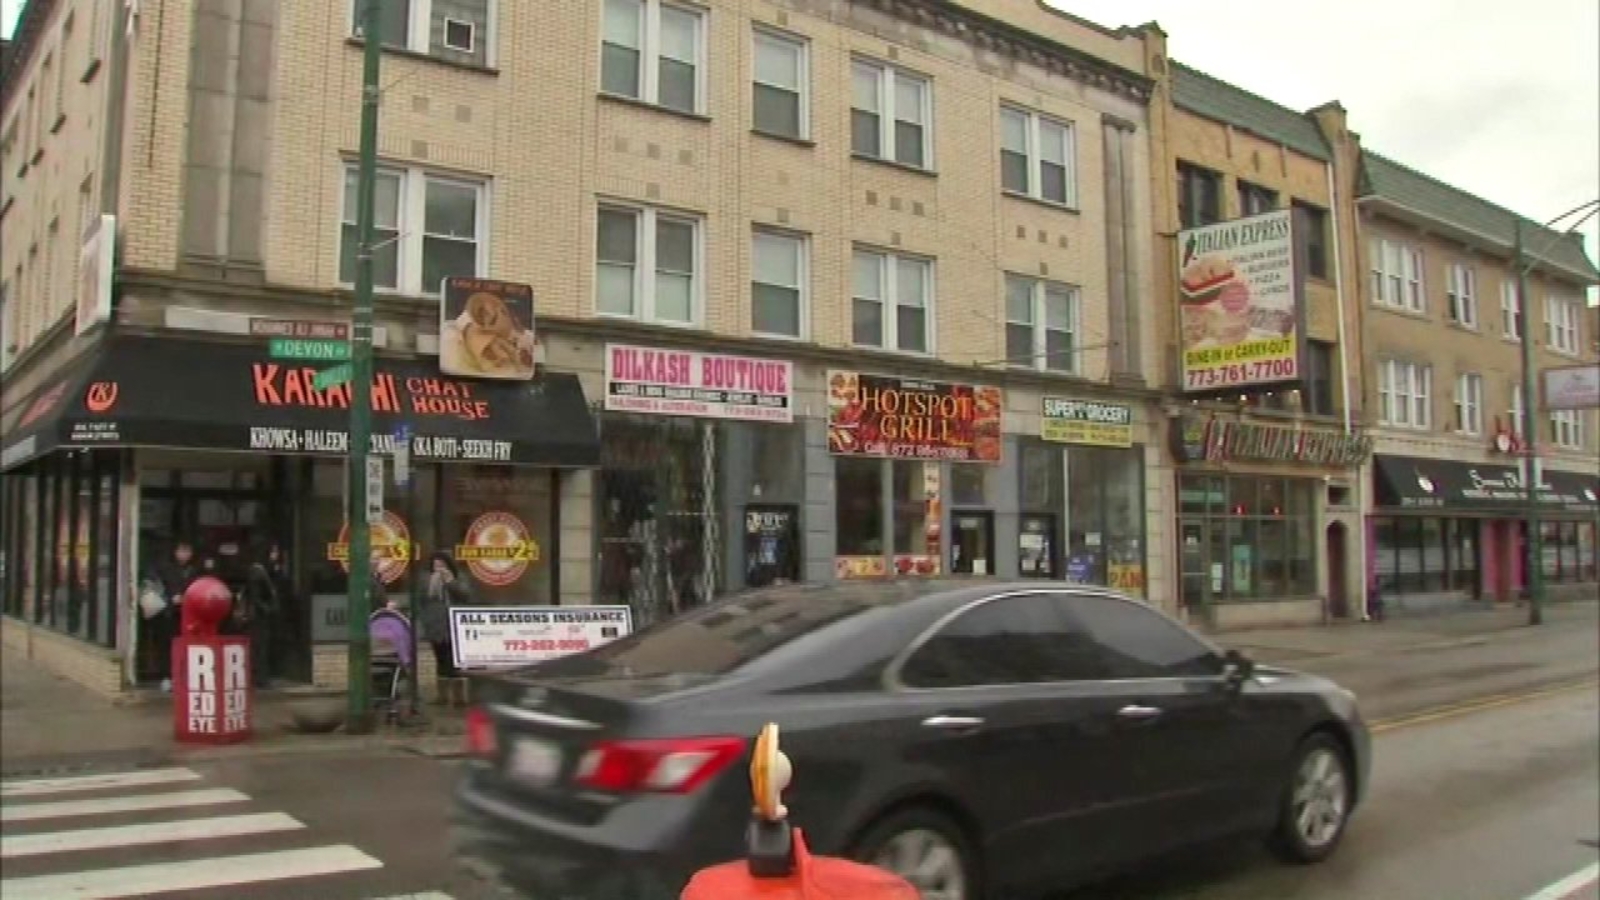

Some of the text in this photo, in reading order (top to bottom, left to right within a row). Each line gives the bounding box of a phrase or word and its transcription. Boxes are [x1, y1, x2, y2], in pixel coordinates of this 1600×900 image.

[1240, 218, 1288, 246] EXPRESS
[612, 347, 691, 386] DILKASH
[702, 356, 786, 395] BOUTIQUE
[1187, 357, 1295, 386] 773-761-7700
[252, 362, 400, 413] KARAHI
[406, 377, 472, 400] CHAT
[411, 395, 490, 422] HOUSE
[861, 386, 972, 421] HOTSPOT
[250, 426, 299, 450] KHOWSA
[305, 430, 348, 451] HALEEM
[460, 612, 624, 623] ALL SEASONS INSURANCE
[187, 645, 246, 691] R R
[189, 692, 216, 715] ED
[189, 717, 216, 733] EYE
